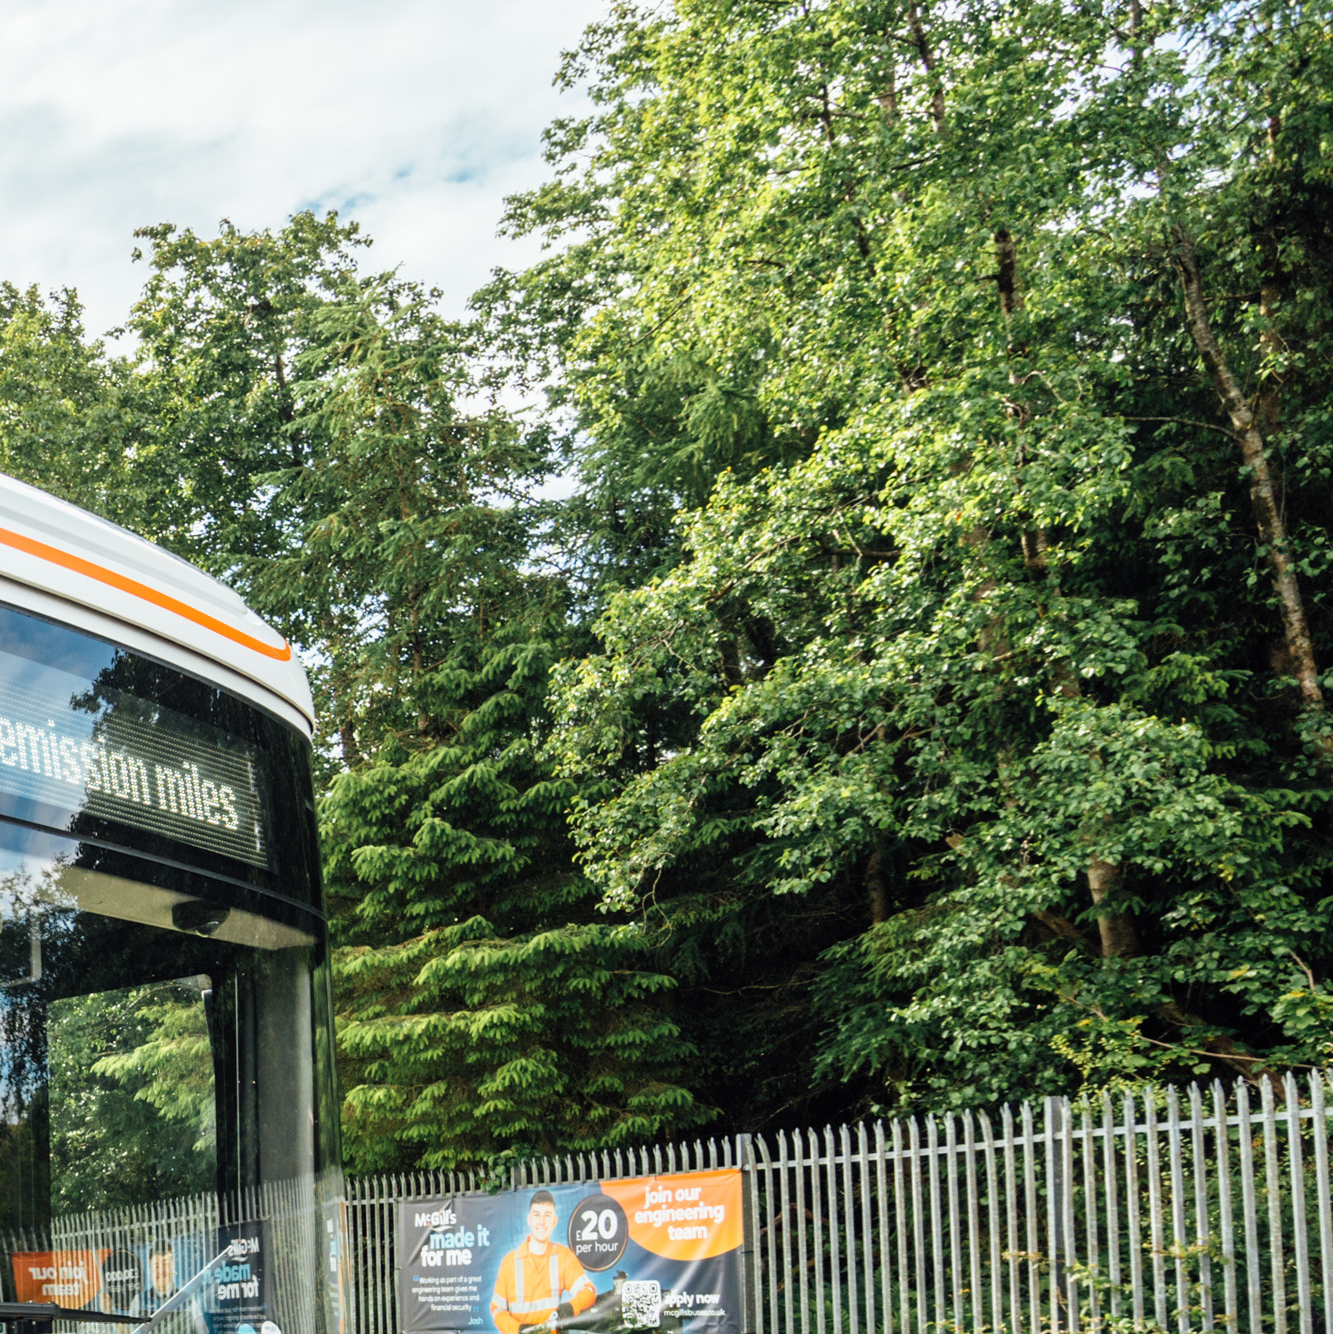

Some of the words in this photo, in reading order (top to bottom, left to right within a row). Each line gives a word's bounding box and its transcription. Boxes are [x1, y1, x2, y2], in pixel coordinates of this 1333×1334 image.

[154, 760, 239, 830] miles
[644, 1185, 672, 1209] join
[675, 1187, 701, 1201] our
[414, 1209, 457, 1228] McGill's
[576, 1208, 618, 1241] £20
[634, 1202, 725, 1227] engineering
[430, 1225, 475, 1249] made
[477, 1223, 490, 1247] it
[668, 1225, 708, 1240] team
[420, 1244, 444, 1267] for
[446, 1248, 472, 1266] me
[576, 1244, 591, 1255] per
[595, 1241, 618, 1253] hour
[664, 1289, 694, 1306] apply
[696, 1293, 720, 1304] now
